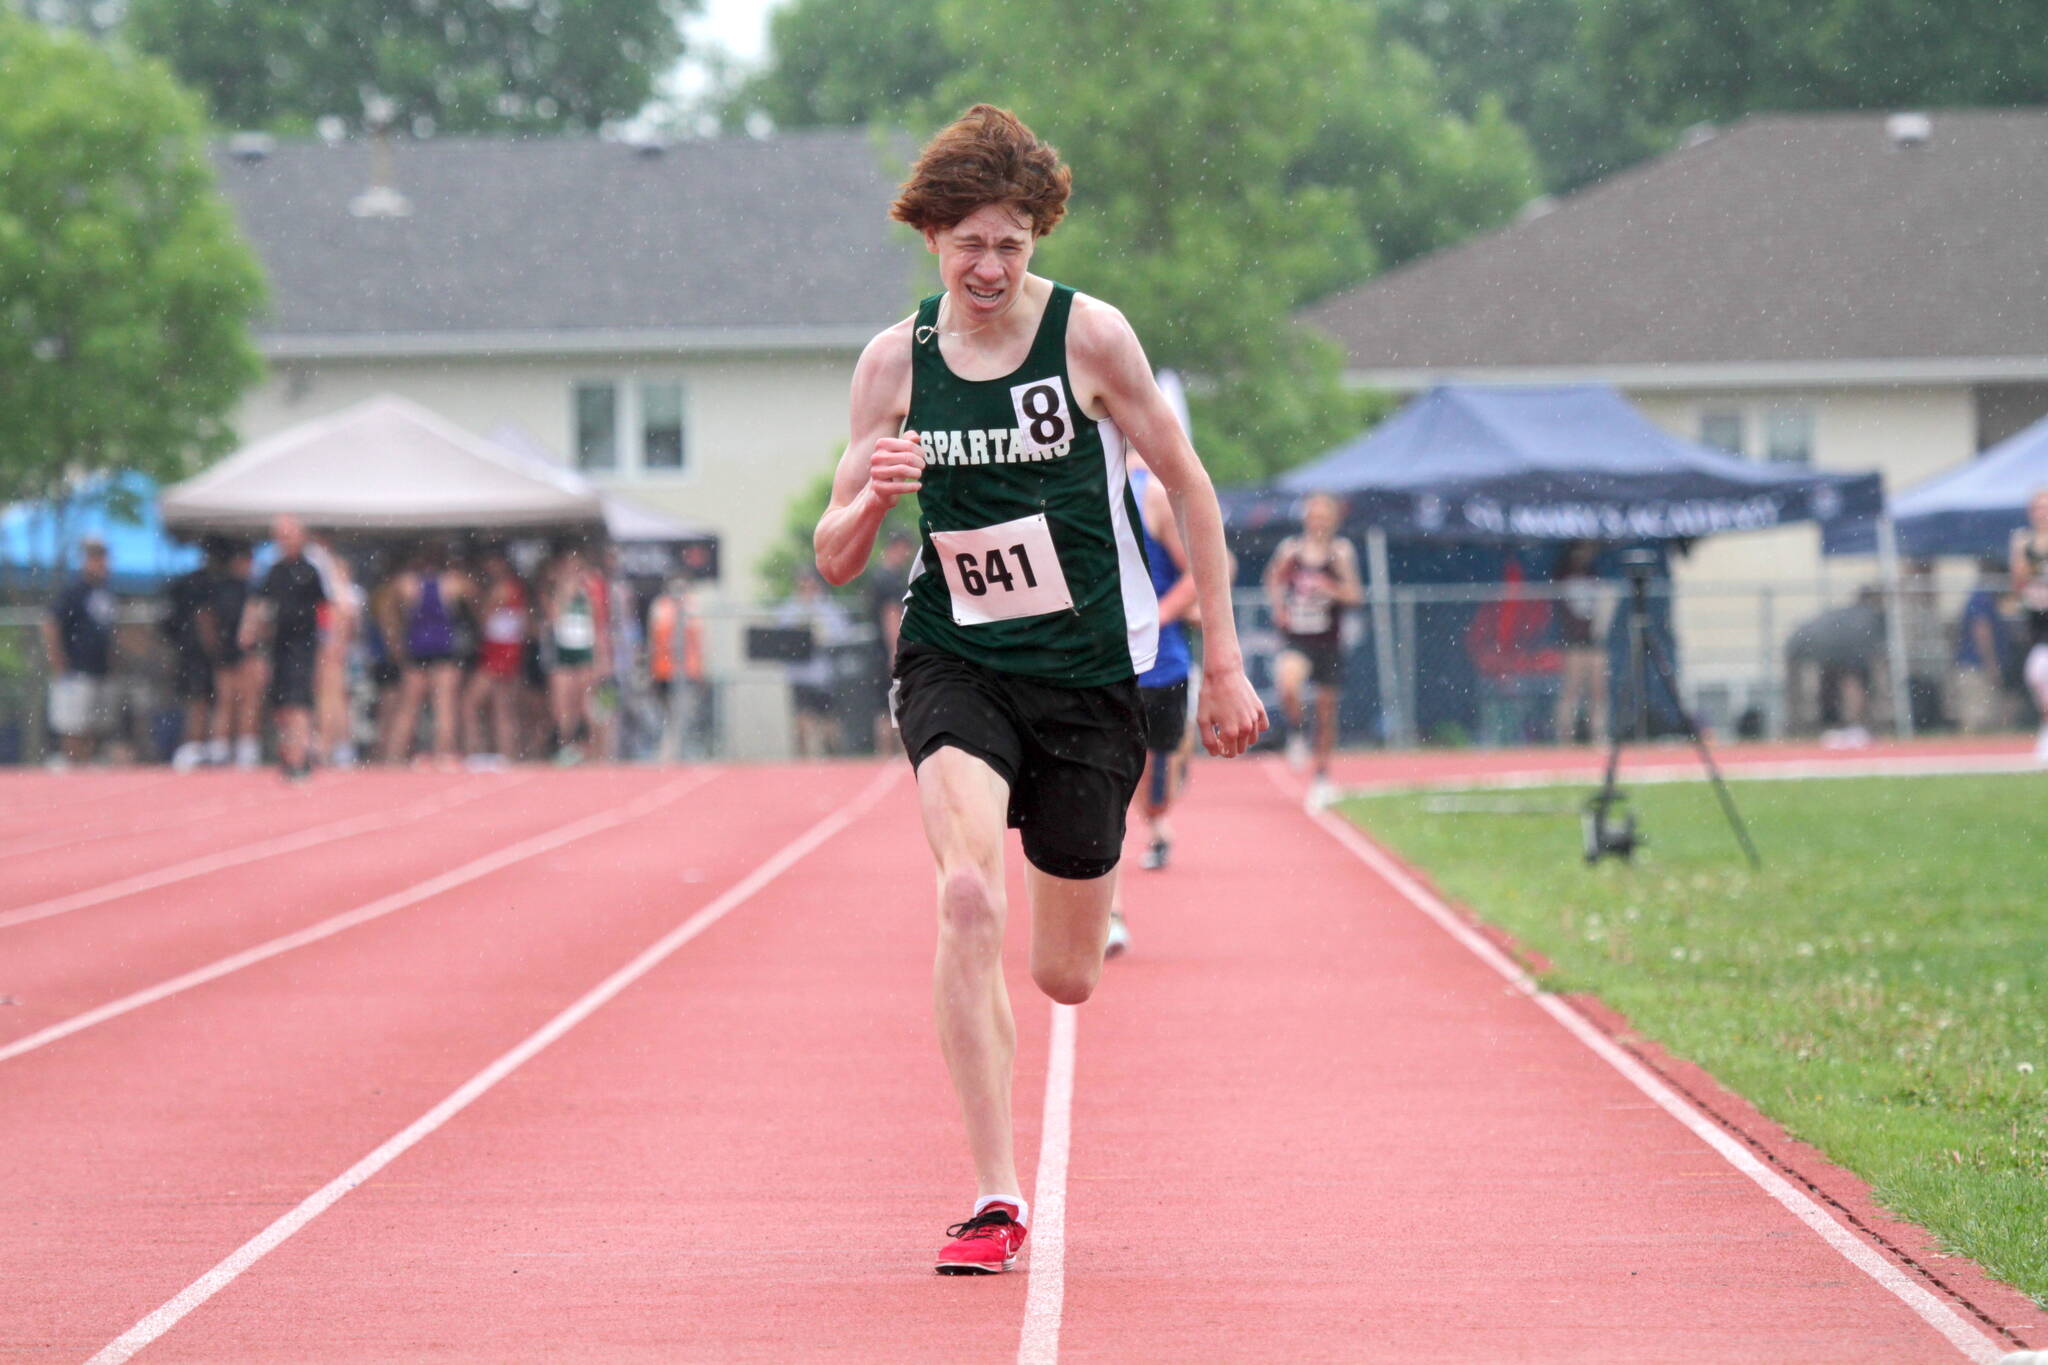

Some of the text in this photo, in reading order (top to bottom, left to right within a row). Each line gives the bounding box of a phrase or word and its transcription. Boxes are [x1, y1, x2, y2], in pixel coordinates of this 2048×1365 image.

[1022, 384, 1065, 445] 8
[920, 428, 1071, 466] SPARTA
[955, 543, 1038, 596] 641
